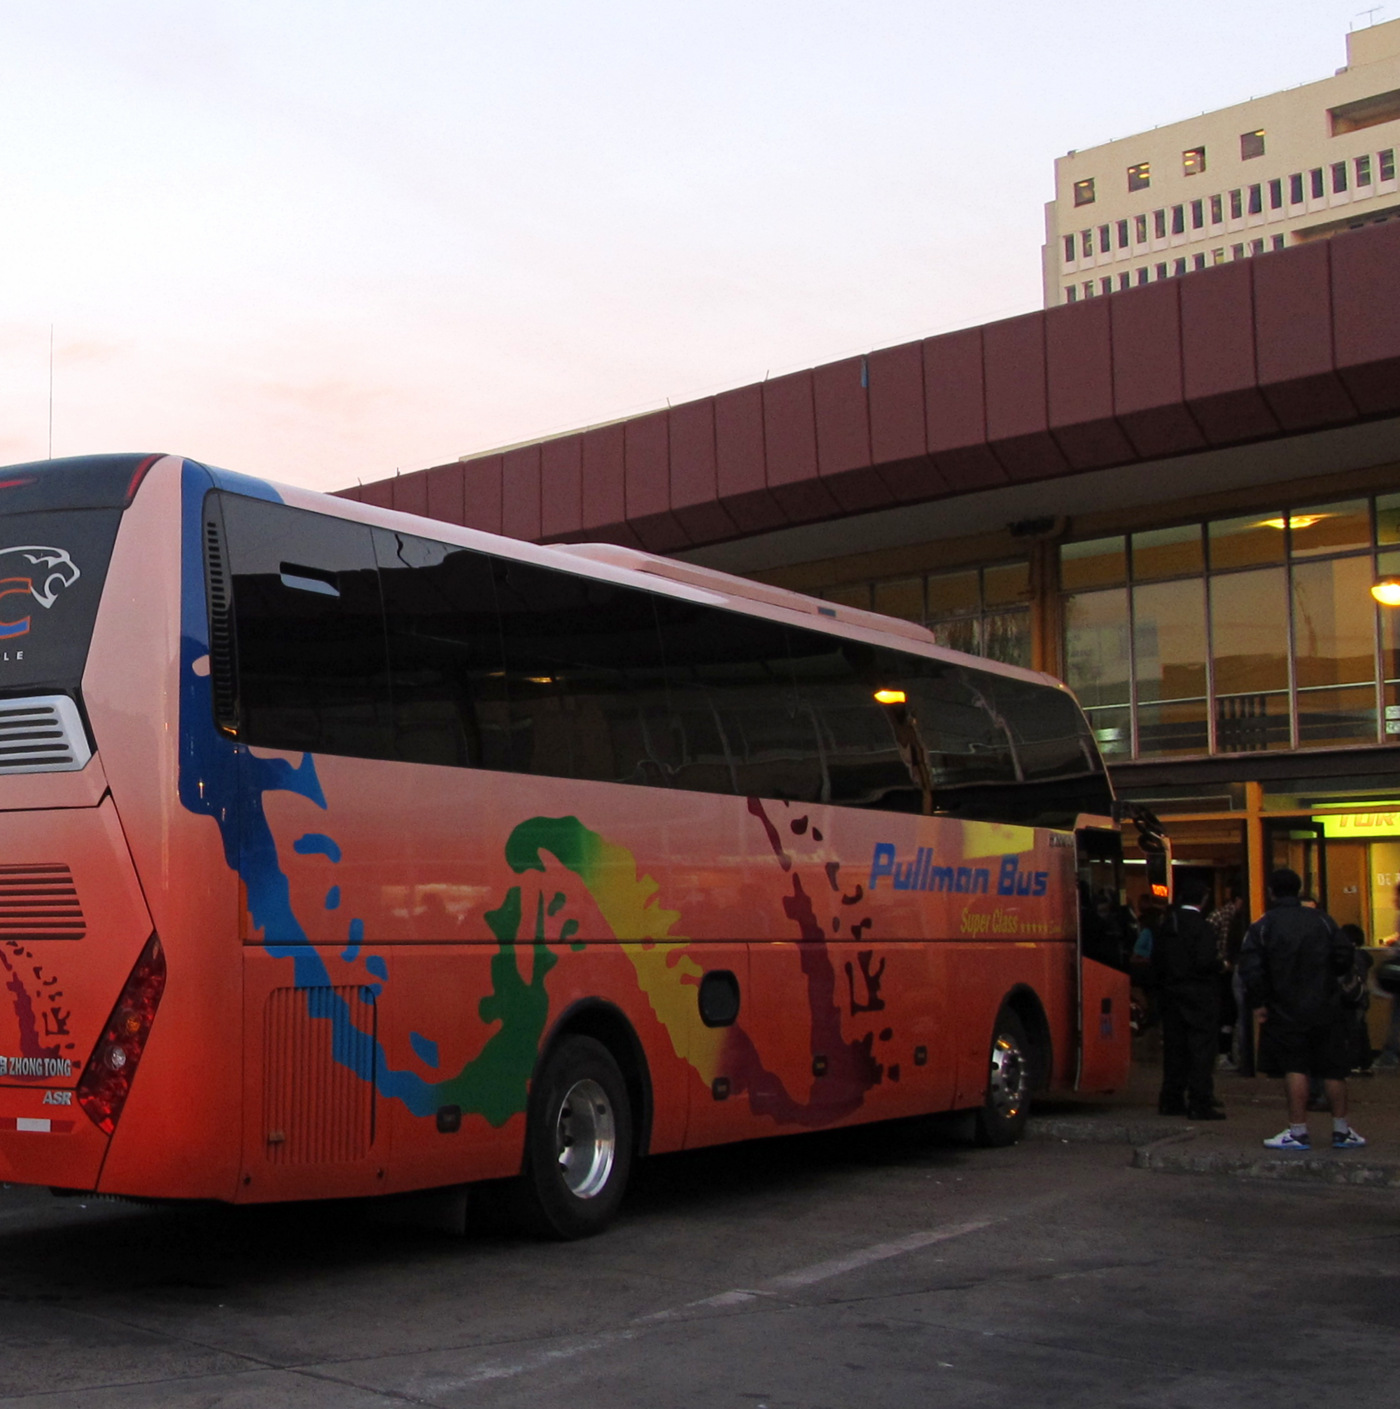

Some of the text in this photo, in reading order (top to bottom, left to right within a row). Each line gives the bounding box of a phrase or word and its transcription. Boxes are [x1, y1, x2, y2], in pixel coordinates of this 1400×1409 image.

[868, 842, 1049, 896] Pullman Bus
[960, 907, 990, 939] Super
[991, 908, 1018, 934] Class
[9, 1056, 72, 1077] ZHONG TONG
[42, 1090, 73, 1106] ASR
